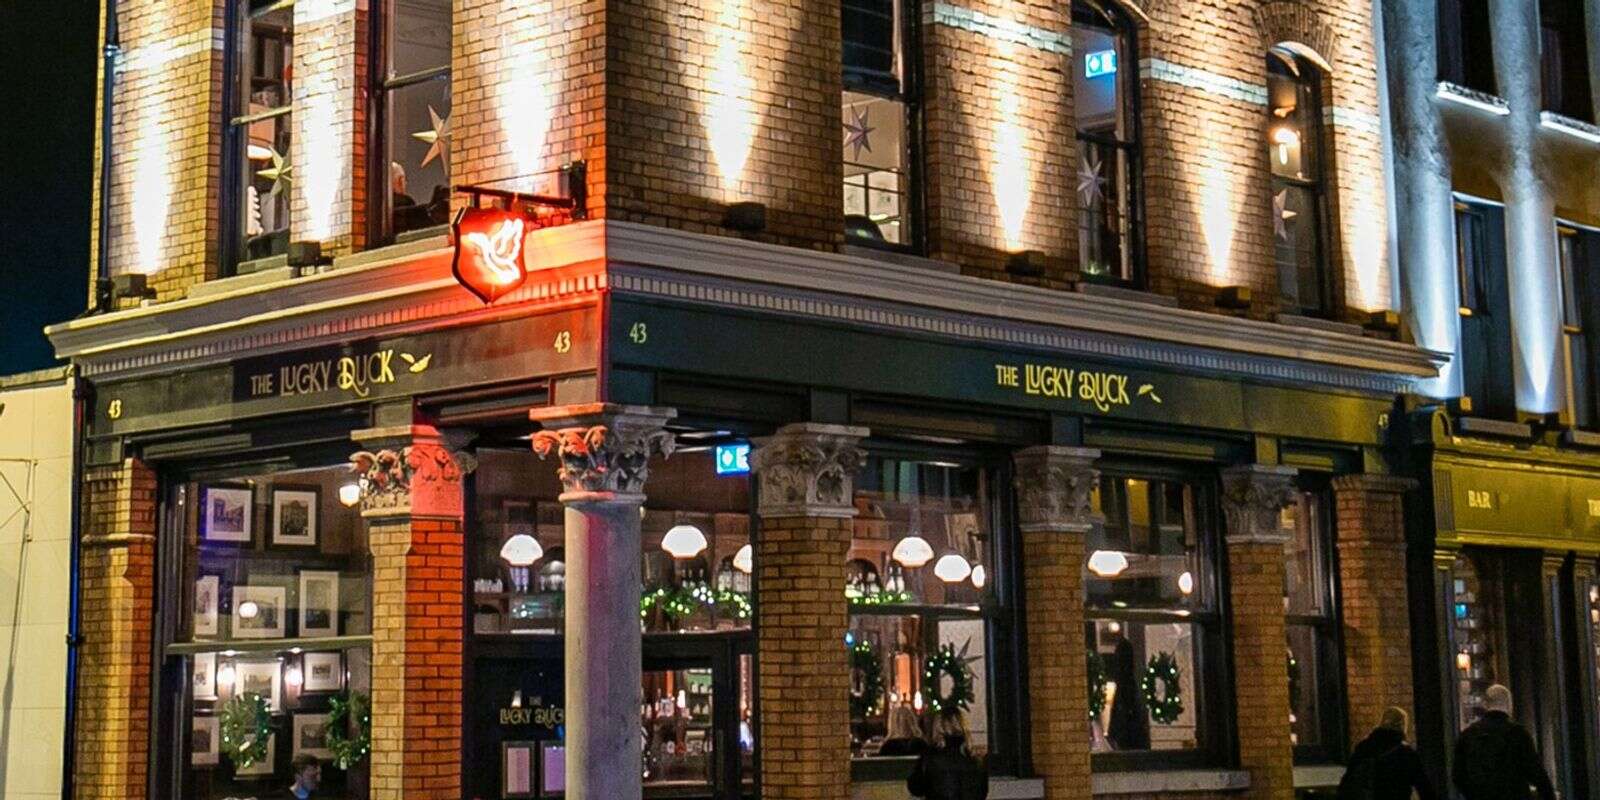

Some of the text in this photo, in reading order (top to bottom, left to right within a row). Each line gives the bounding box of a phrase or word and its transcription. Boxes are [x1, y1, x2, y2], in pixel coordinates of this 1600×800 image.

[554, 331, 571, 353] 43
[629, 322, 647, 344] 43
[251, 349, 395, 397] THE LUCKY DUCK
[995, 364, 1130, 412] THE LUCKY DUCK
[108, 399, 121, 419] 43
[1468, 490, 1491, 509] BAR
[500, 708, 564, 729] LUCKY DUC
